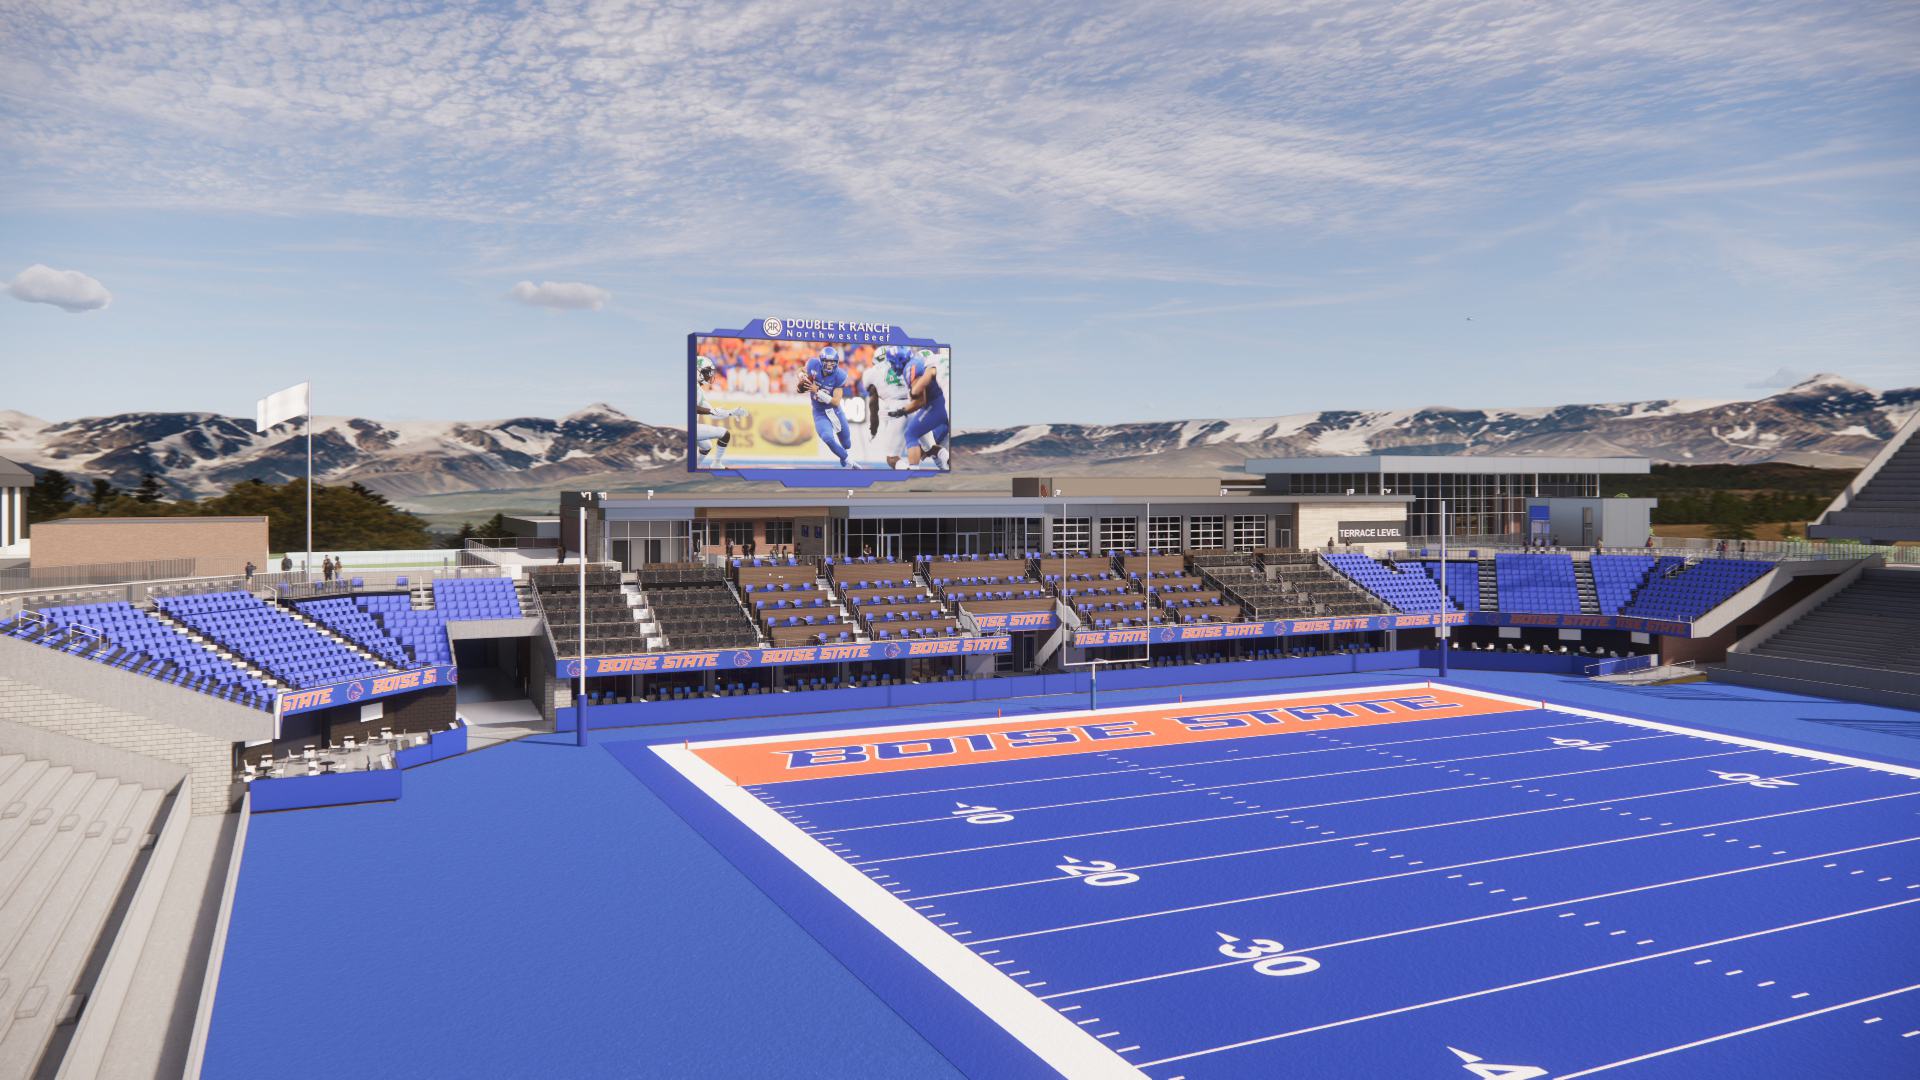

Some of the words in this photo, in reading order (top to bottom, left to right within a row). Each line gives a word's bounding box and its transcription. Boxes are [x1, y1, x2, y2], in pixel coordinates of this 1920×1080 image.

[786, 318, 835, 331] DOUBLE
[838, 321, 846, 331] R
[849, 321, 890, 334] RANCH
[786, 330, 858, 341] Northwest
[864, 333, 890, 342] Beef
[1339, 529, 1376, 538] TERRACE
[1377, 528, 1401, 537] LEVEL
[1010, 613, 1053, 627] STATE
[1292, 619, 1332, 633] BOISE
[1333, 617, 1369, 630] STATE
[1395, 615, 1431, 627] BOISE
[1509, 613, 1560, 626] BOISE
[1562, 615, 1611, 627] STATE
[1181, 625, 1223, 639] BOISE
[1225, 623, 1264, 637] STATE
[761, 648, 817, 663] BOISE
[819, 645, 871, 660] STATE
[909, 641, 960, 655] BOISE
[962, 636, 1009, 652] STATE
[597, 656, 659, 673] BOISE
[662, 653, 719, 669] STATE
[371, 672, 421, 695] BOISE
[282, 687, 334, 712] STATE
[772, 721, 1155, 770] BOISE
[1163, 695, 1463, 732] STATE
[951, 805, 1015, 825] 10
[1055, 860, 1140, 887] 20
[1218, 938, 1321, 977] 30
